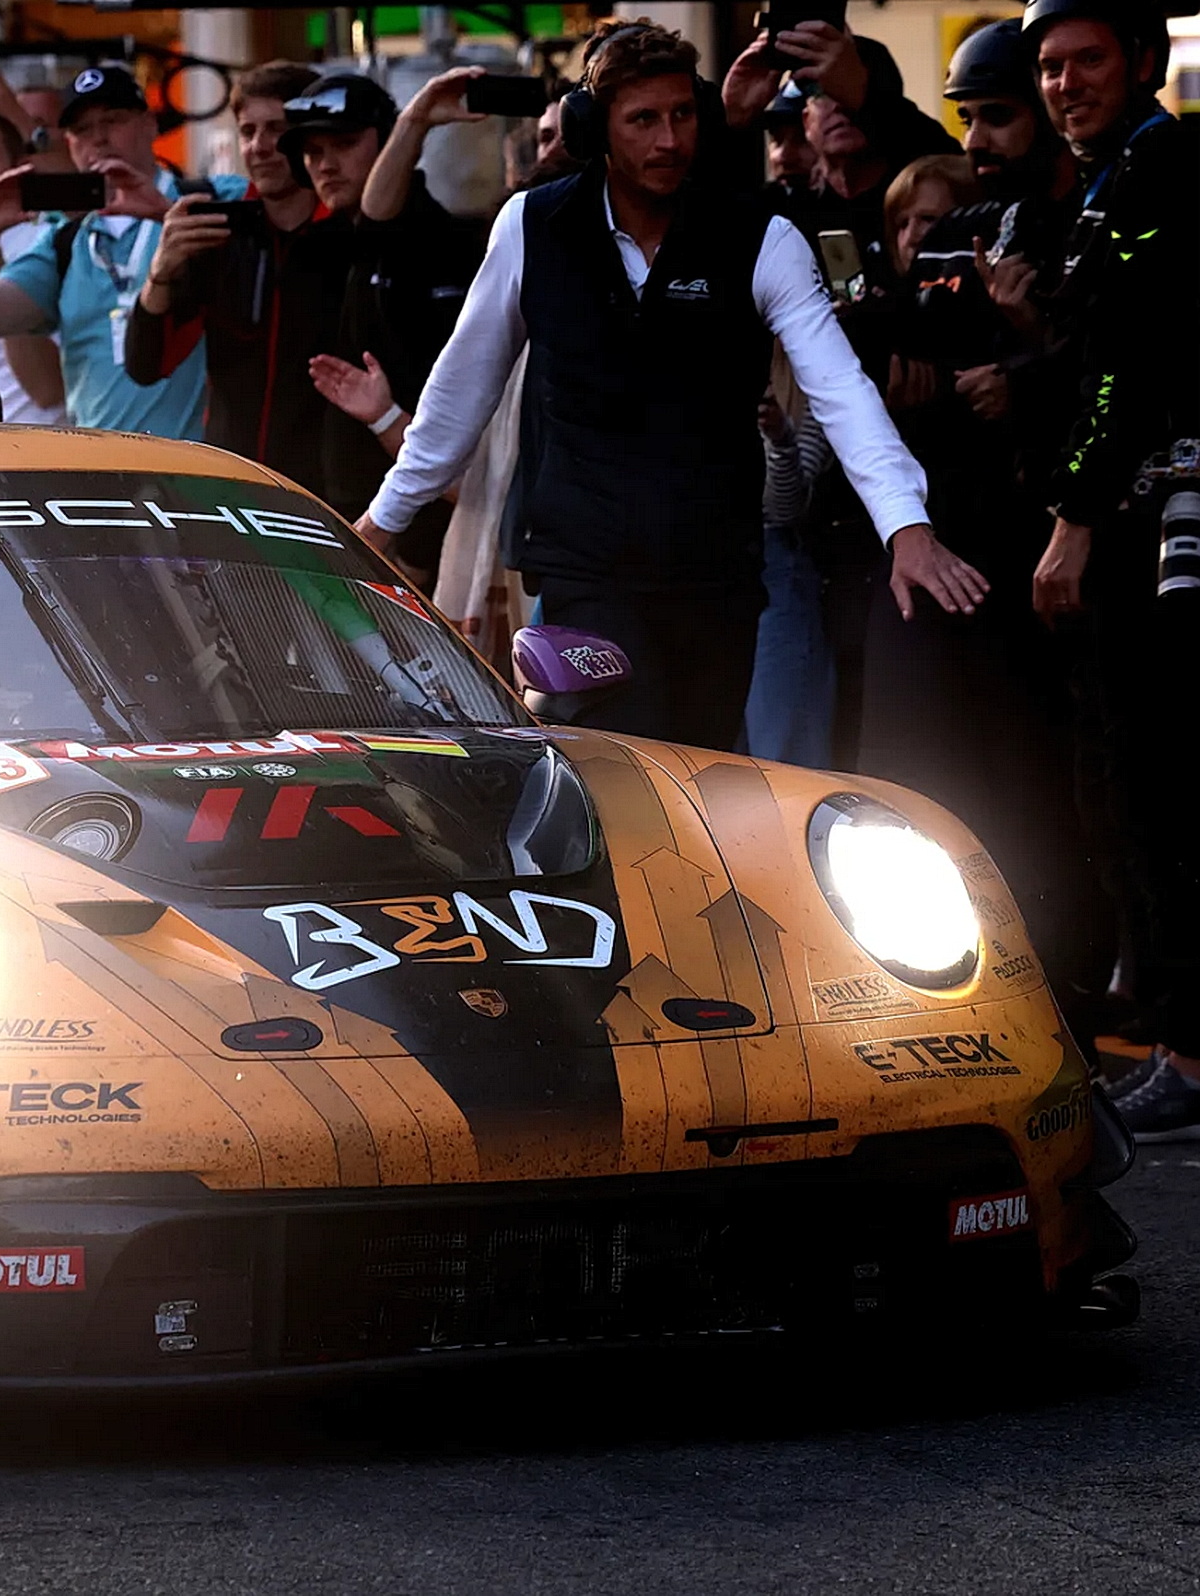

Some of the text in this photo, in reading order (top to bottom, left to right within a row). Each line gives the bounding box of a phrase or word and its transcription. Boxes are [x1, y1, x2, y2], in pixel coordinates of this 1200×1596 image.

[65, 734, 342, 759] MOTUL
[179, 766, 232, 779] FIA
[879, 1064, 1022, 1085] ELECTRICAL TECHNOLOGIES
[5, 1113, 142, 1127] TECHNOLOGIES
[953, 1195, 1030, 1236] MOTUL
